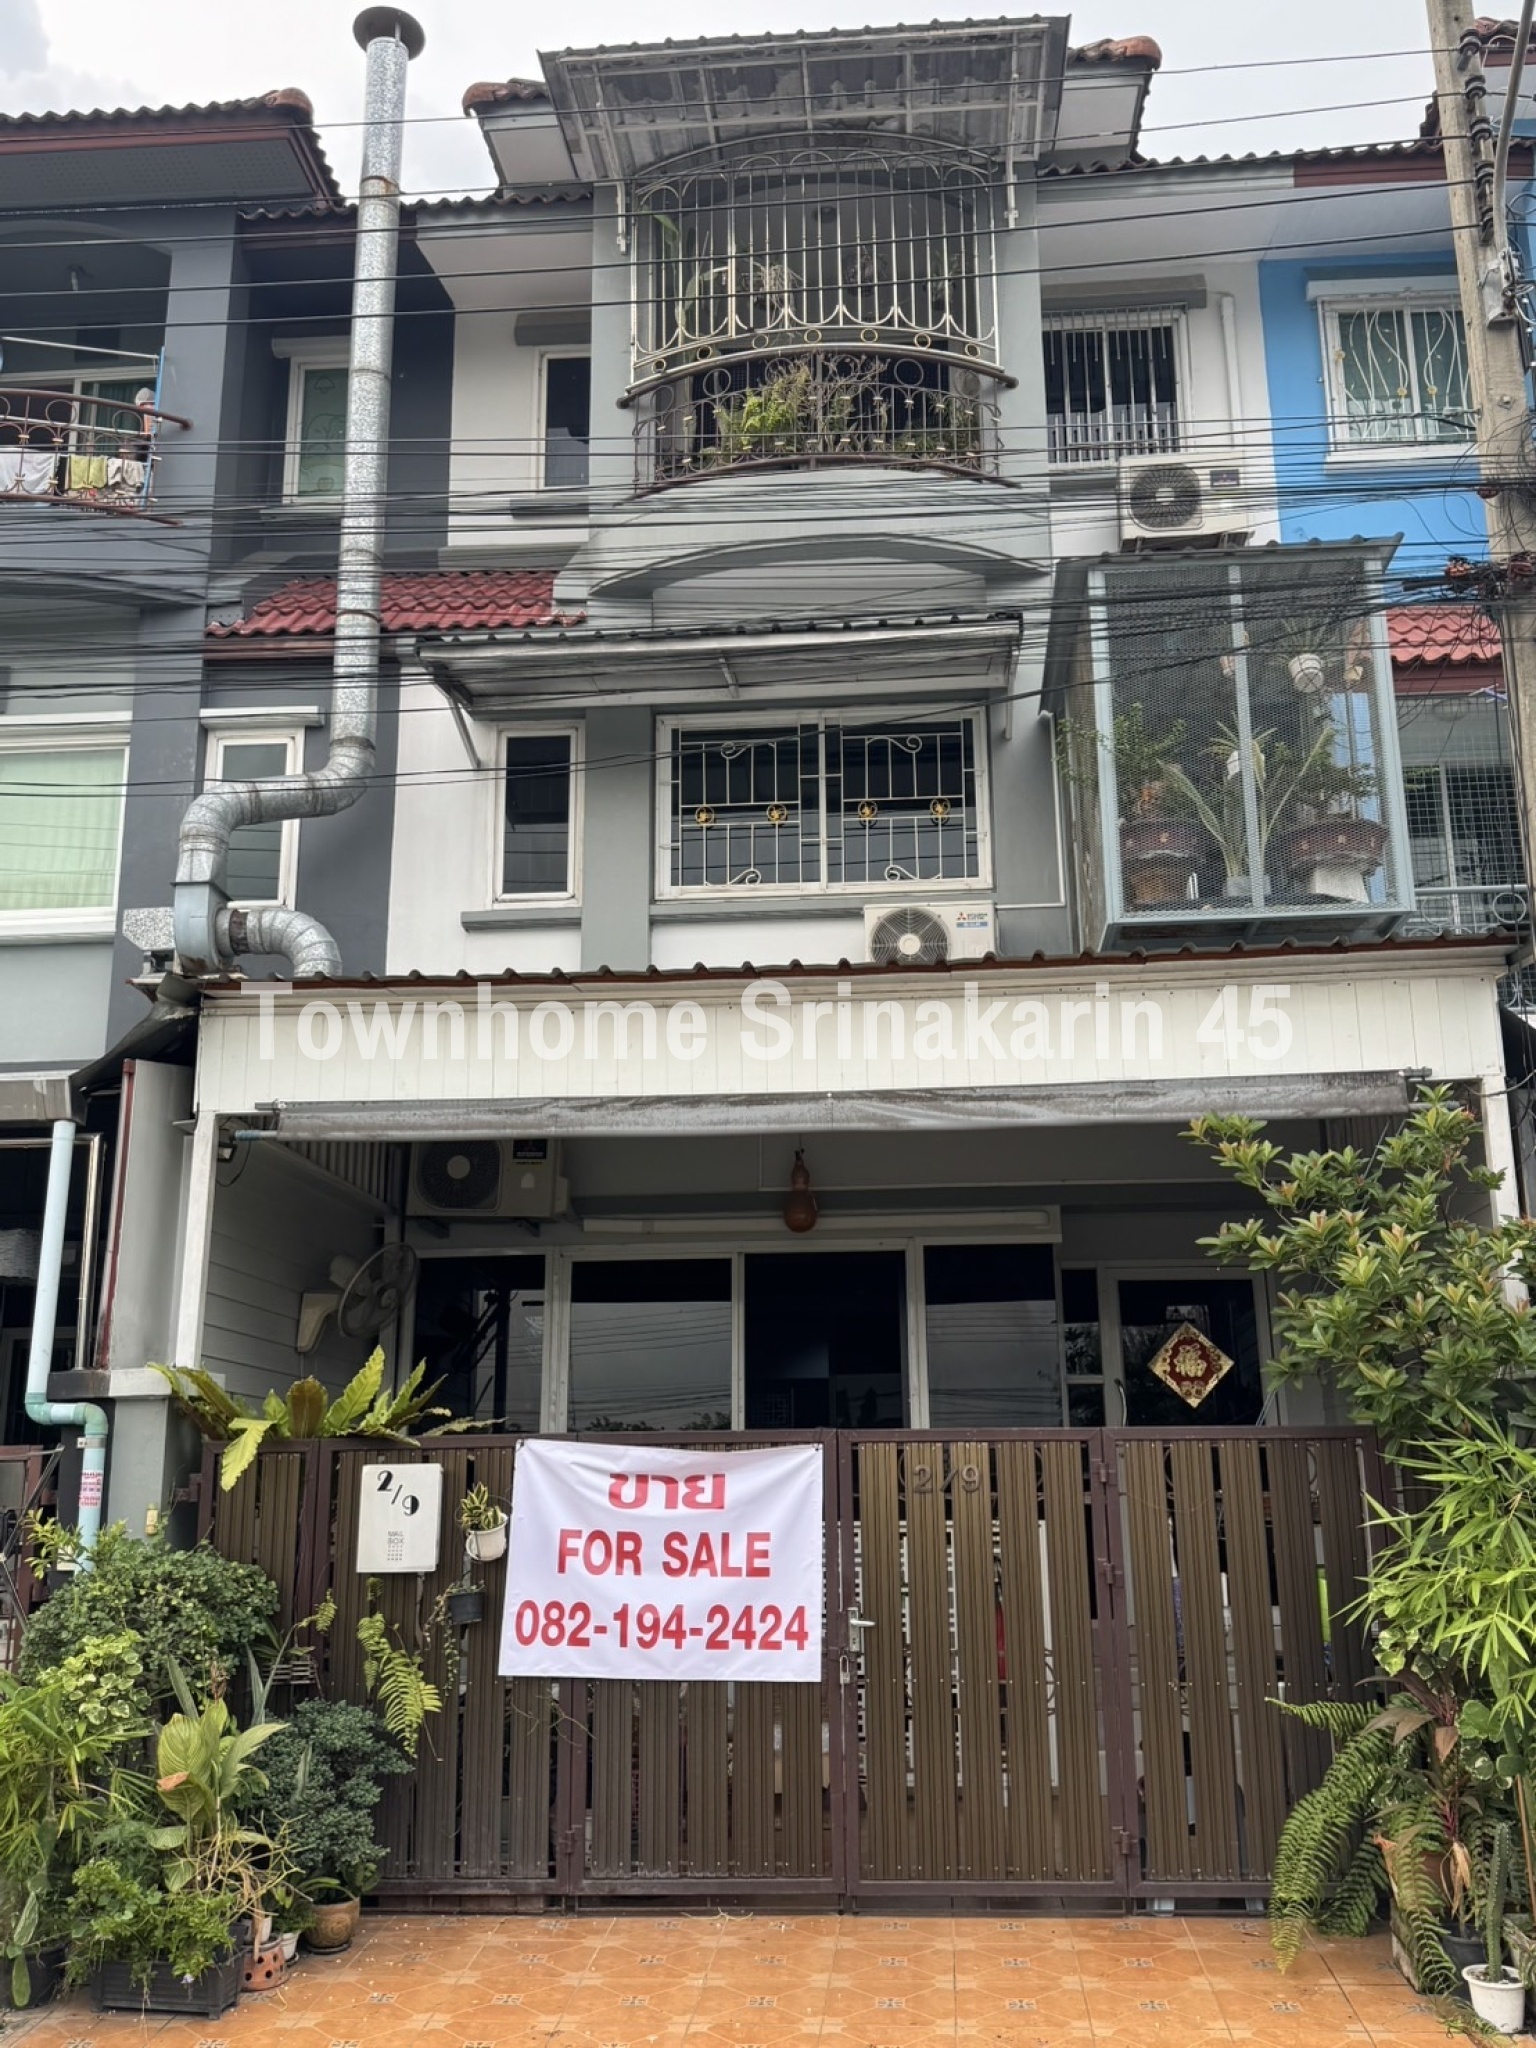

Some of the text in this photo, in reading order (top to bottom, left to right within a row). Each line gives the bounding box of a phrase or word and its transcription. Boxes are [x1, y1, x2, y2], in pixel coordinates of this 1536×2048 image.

[377, 1469, 420, 1517] 2/9
[608, 1472, 726, 1511] ขาย
[912, 1464, 980, 1494] 2/9
[557, 1528, 772, 1578] FOR SALE
[515, 1599, 810, 1651] 082-194-2424
